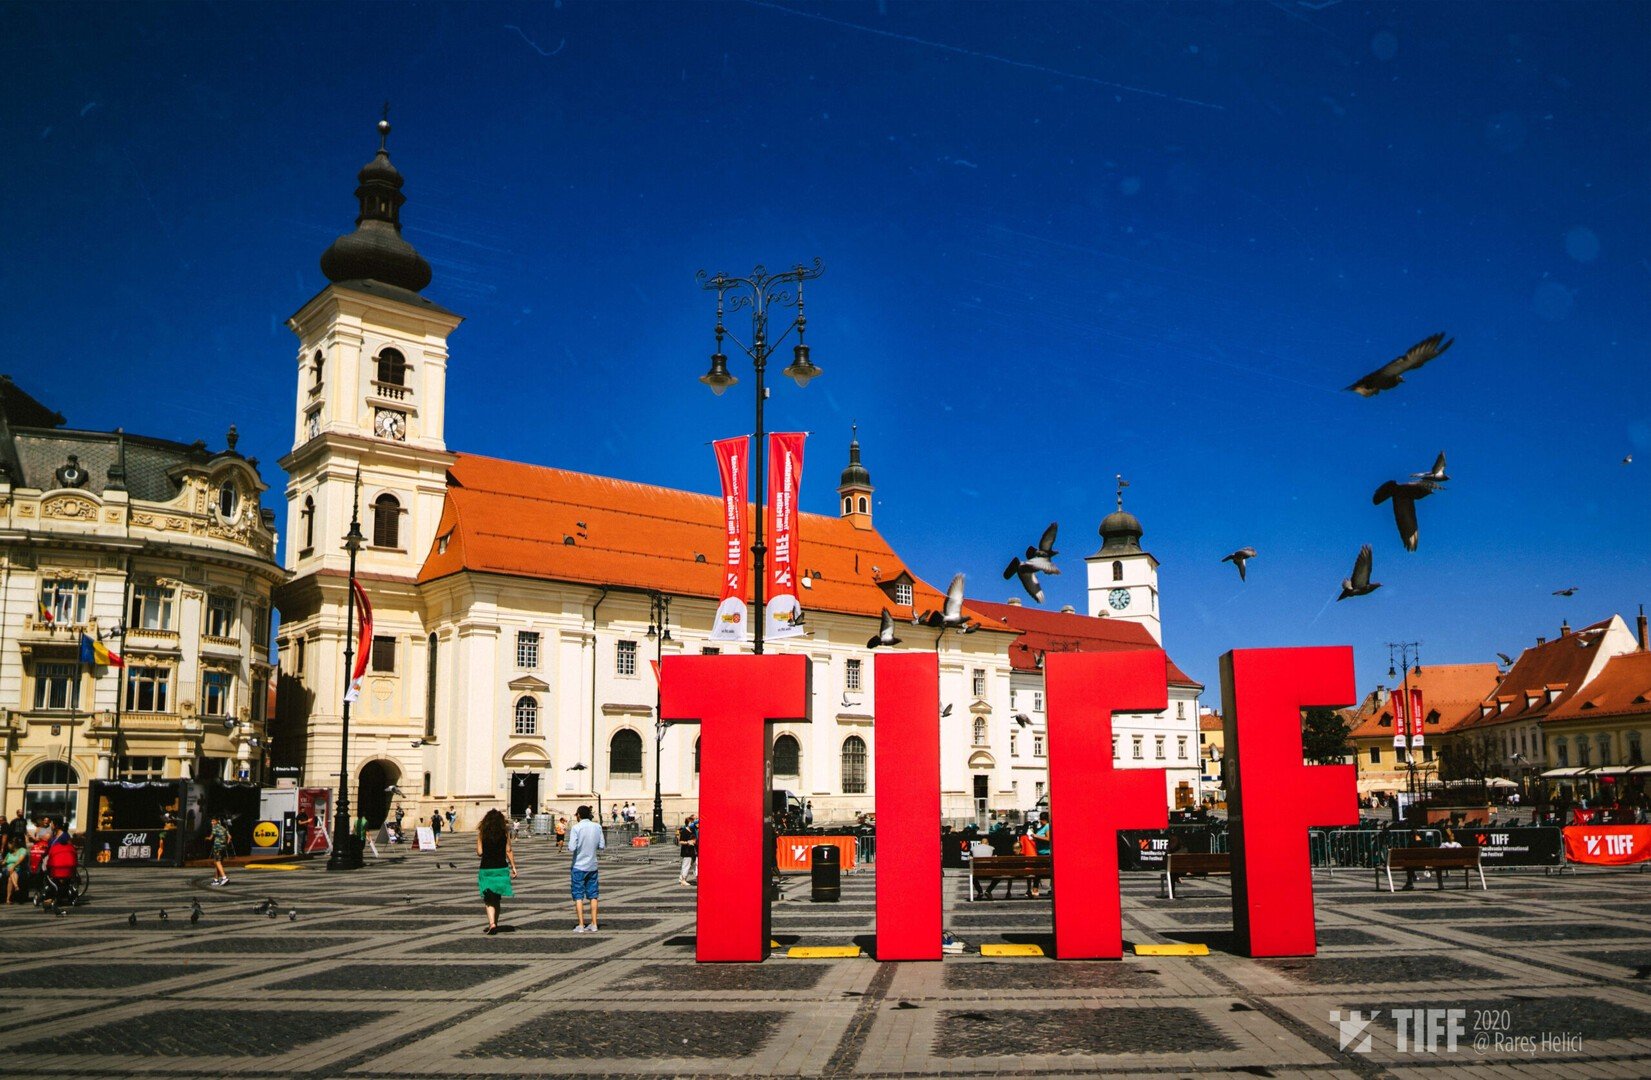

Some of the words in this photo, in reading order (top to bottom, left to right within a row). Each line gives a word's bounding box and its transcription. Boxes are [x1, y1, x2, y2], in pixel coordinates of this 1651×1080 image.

[661, 647, 1358, 961] TIFF
[122, 832, 147, 846] Lidl
[1151, 839, 1168, 850] TIFF
[1490, 833, 1510, 845] TIFF
[1604, 834, 1634, 856] TIFF
